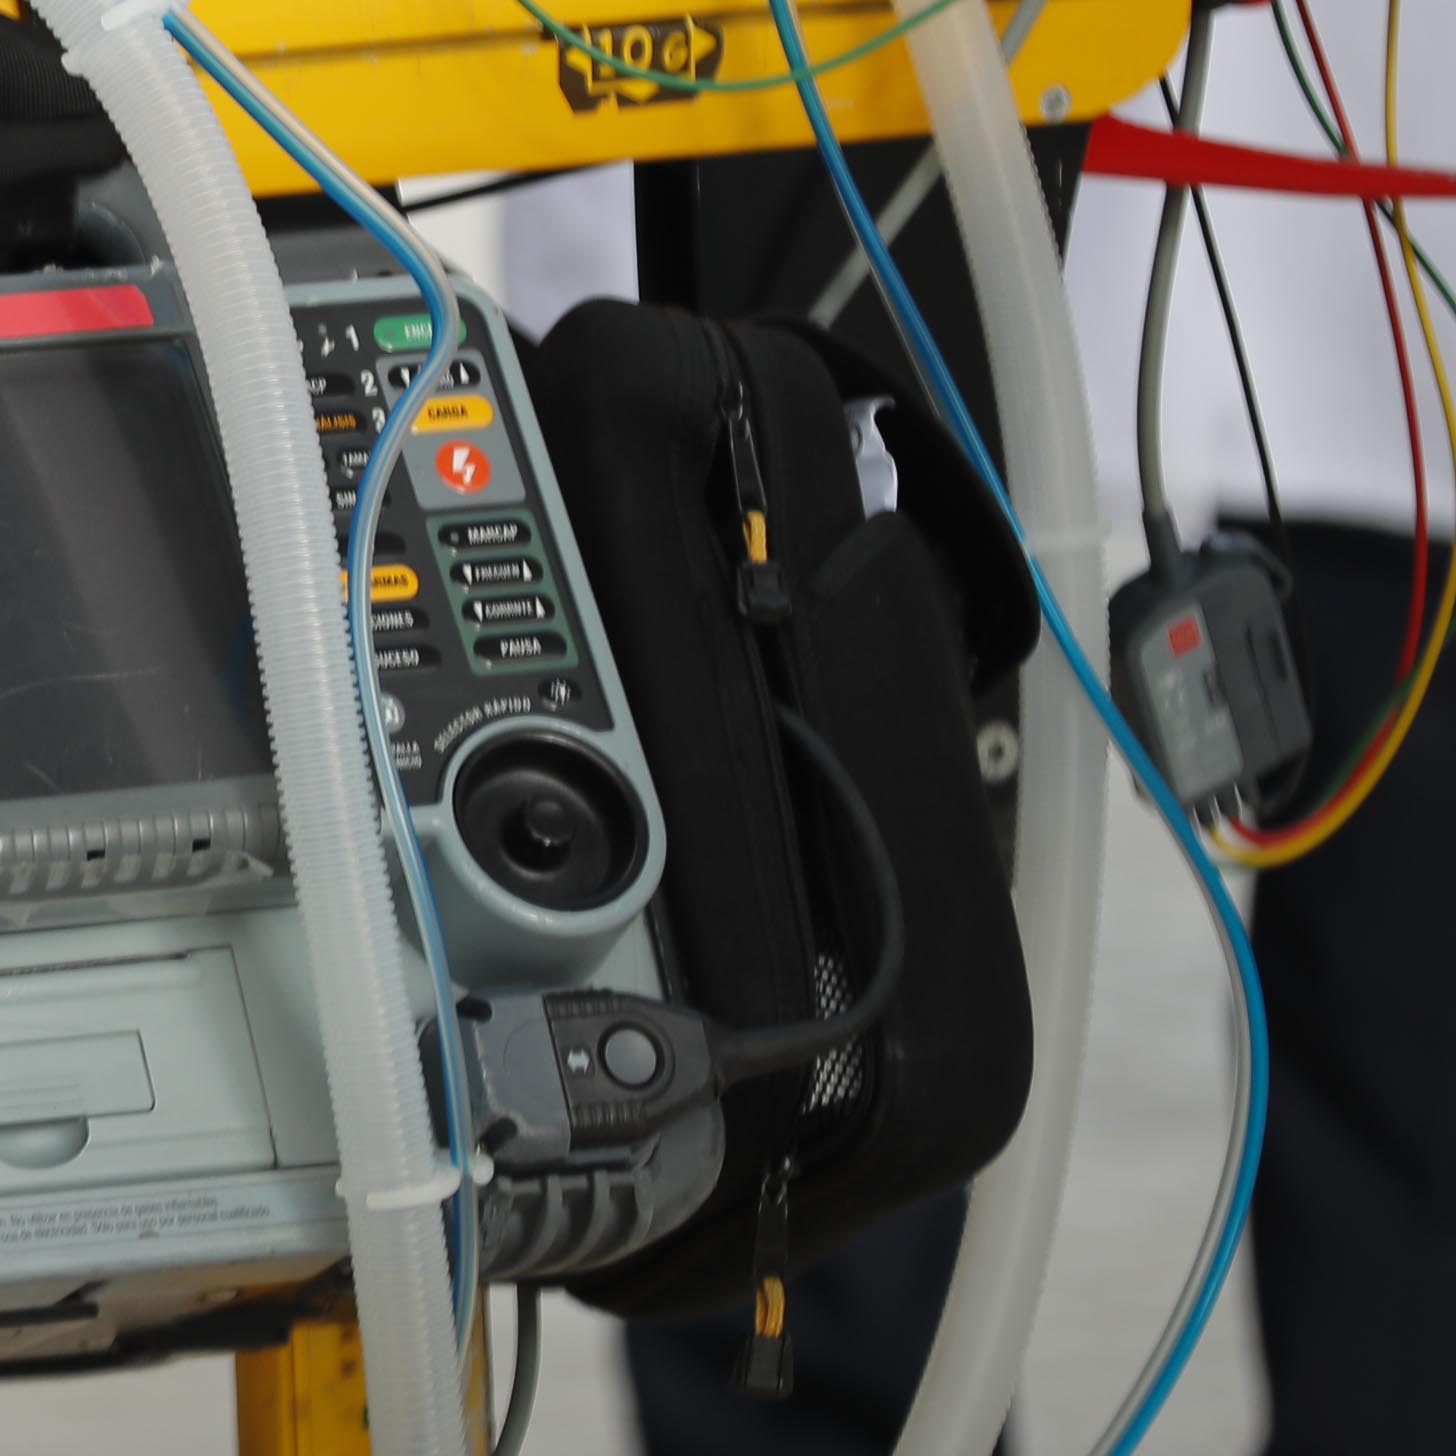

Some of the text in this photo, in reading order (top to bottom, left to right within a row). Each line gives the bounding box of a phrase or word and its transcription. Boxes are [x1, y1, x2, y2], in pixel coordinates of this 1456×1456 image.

[345, 323, 360, 351] 1
[360, 368, 378, 396] 2
[499, 635, 543, 658] PAUSA
